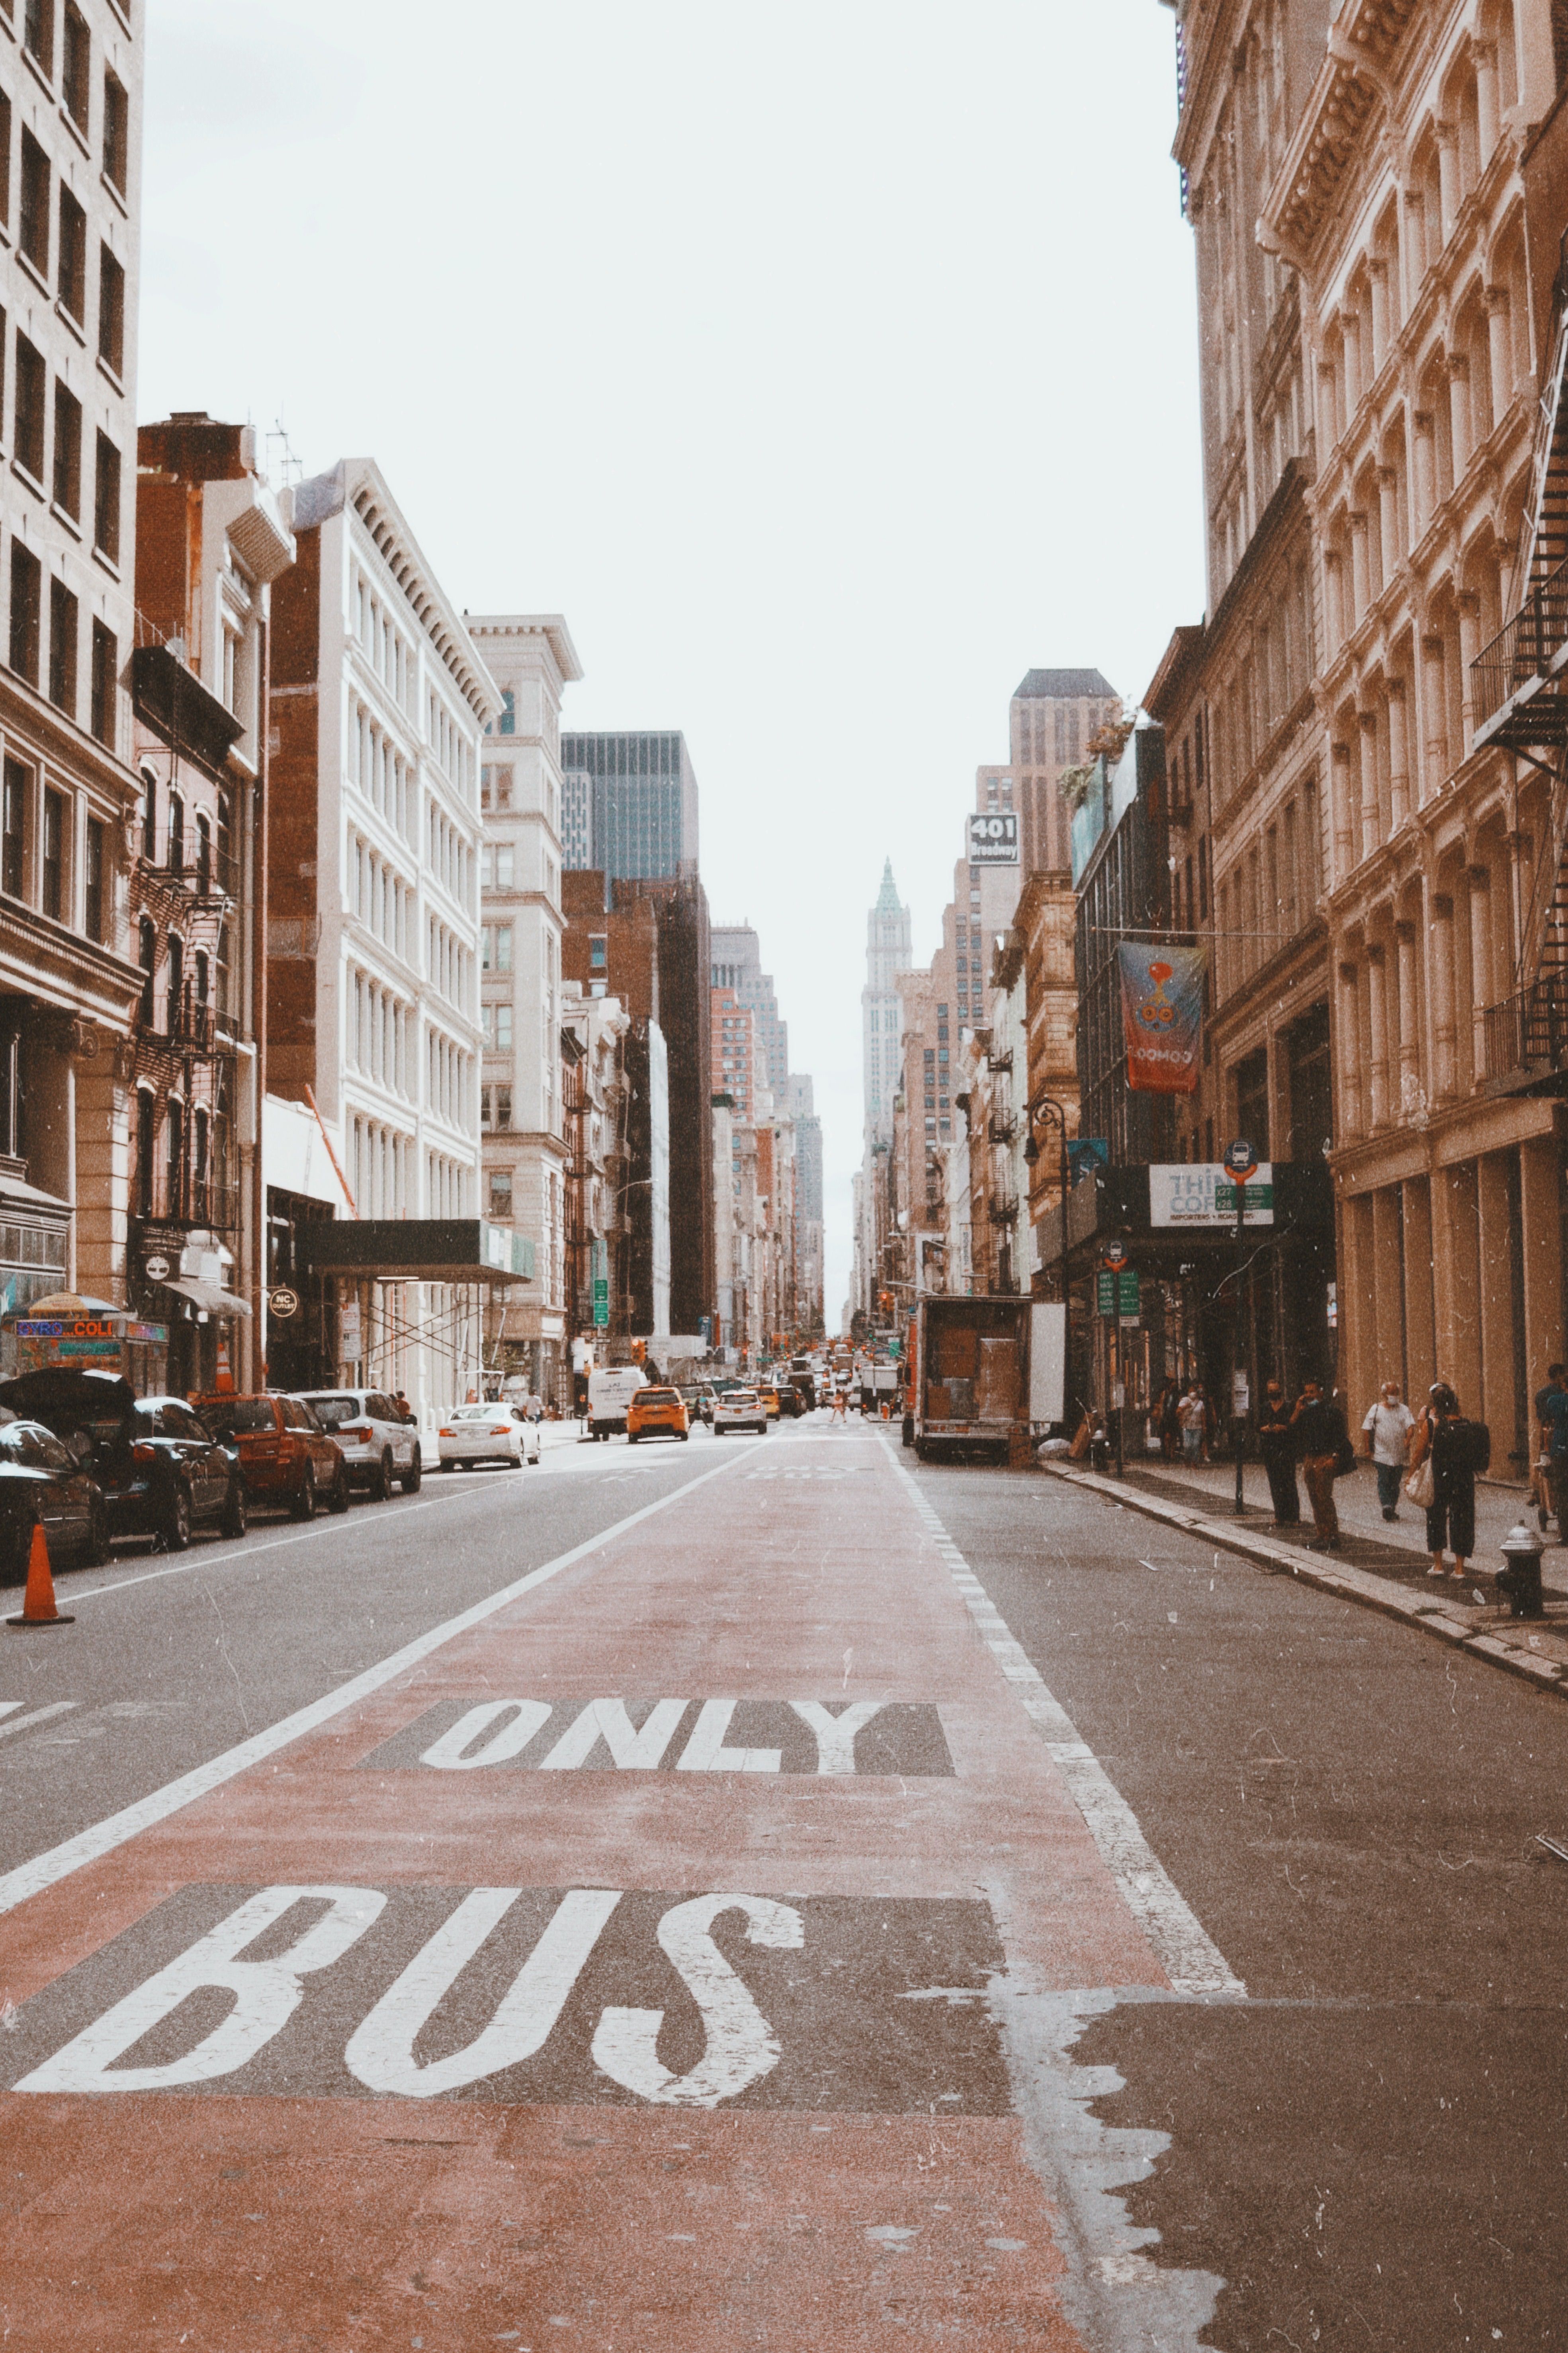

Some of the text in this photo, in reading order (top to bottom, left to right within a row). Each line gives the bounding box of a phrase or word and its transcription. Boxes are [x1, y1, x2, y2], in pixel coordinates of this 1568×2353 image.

[971, 818, 1014, 838] 401
[972, 842, 1017, 859] Broadway
[1169, 1169, 1232, 1195] THiN
[1171, 1196, 1215, 1213] COF
[420, 1698, 887, 1776] ONLY
[13, 1885, 805, 2106] BUS
